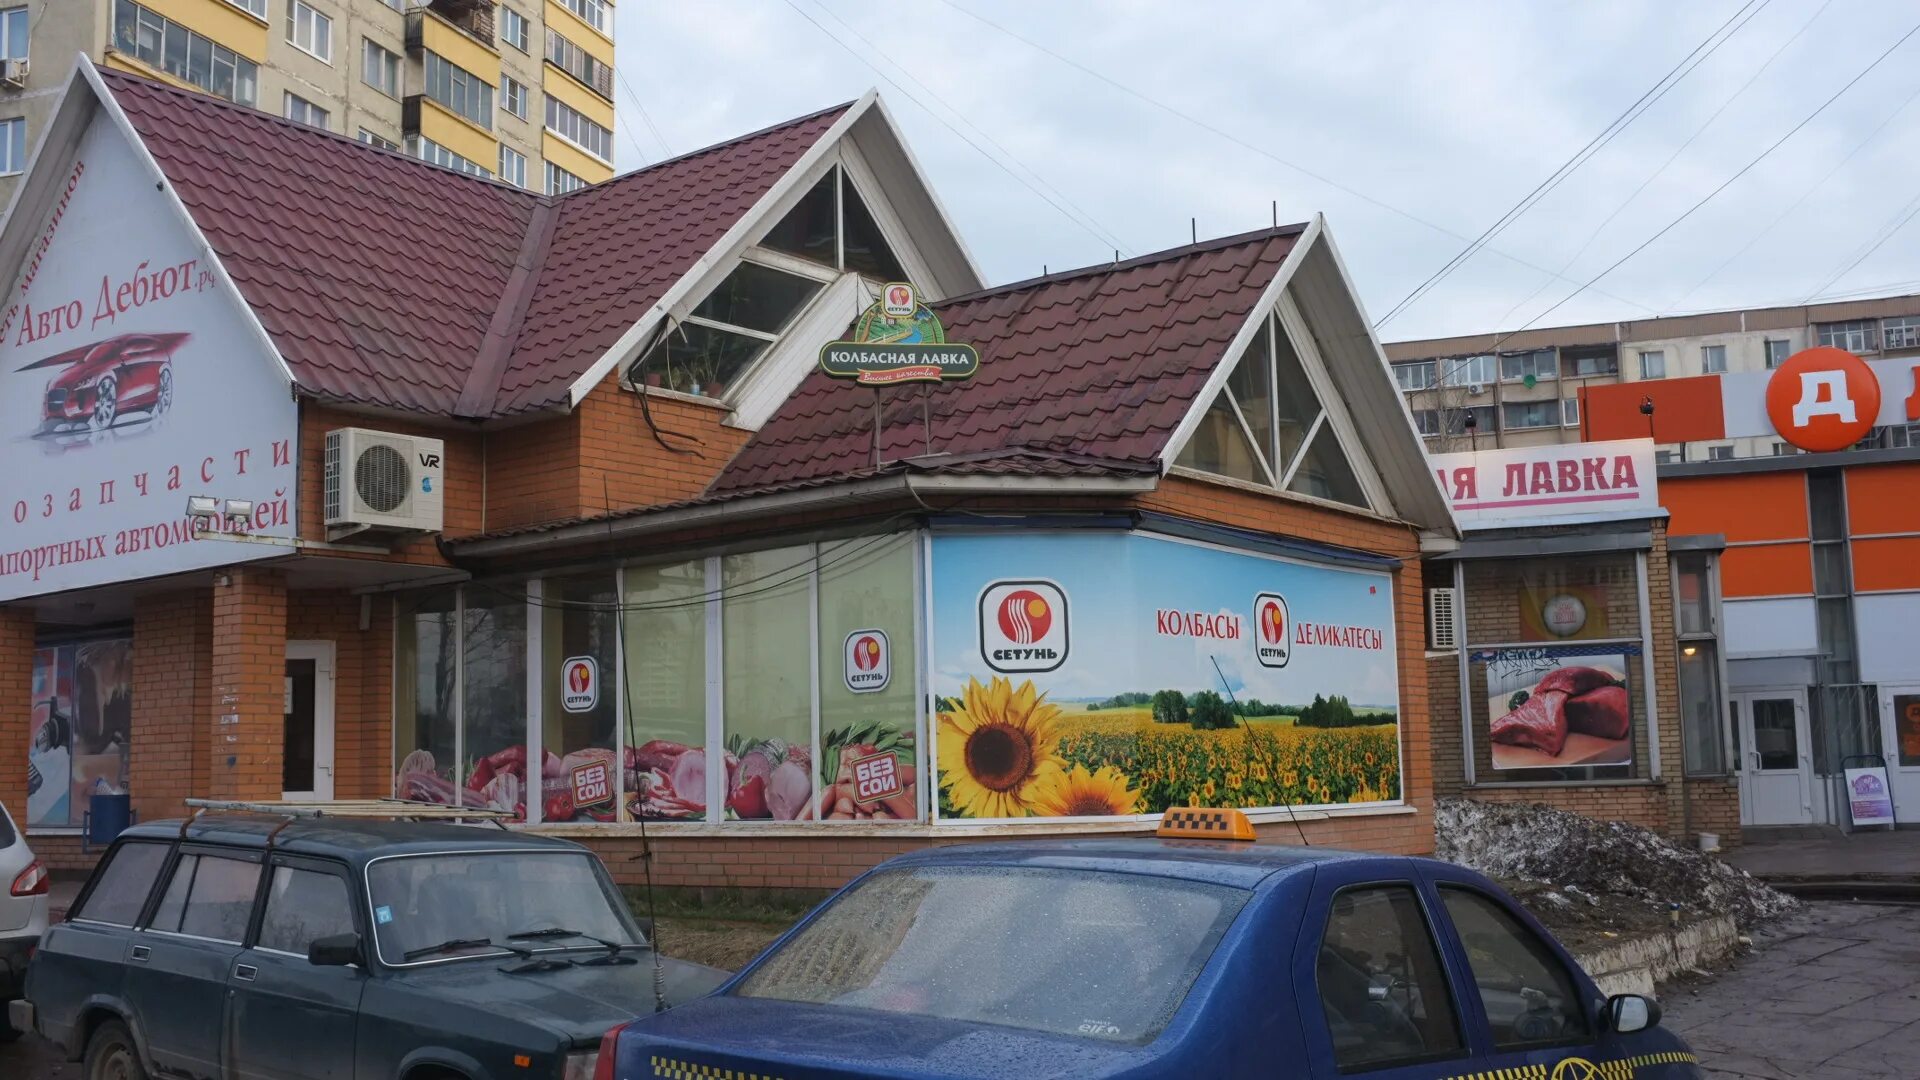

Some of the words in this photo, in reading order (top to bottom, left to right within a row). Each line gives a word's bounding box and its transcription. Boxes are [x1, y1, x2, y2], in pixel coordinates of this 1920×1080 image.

[20, 160, 85, 297] магазинов
[16, 300, 83, 347] Авто
[831, 352, 916, 364] КОЛБАСНАЯ
[921, 353, 969, 365] ЛАВКА
[1792, 369, 1858, 427] Д
[419, 453, 440, 468] VR
[1503, 455, 1639, 497] ЛАВКА
[115, 487, 289, 556] автомобей
[1157, 609, 1239, 639] КОЛБАСЫ
[1295, 623, 1382, 650] ДЕЛИКАТЕСЫ
[993, 648, 1058, 660] СЕТУНЬ
[1260, 648, 1286, 658] СЕТУНЬ
[852, 673, 883, 682] СЕТУНЬ
[575, 766, 605, 787] БЕЗ
[856, 757, 894, 782] БЕЗ
[577, 781, 606, 800] СОИ
[859, 774, 896, 797] СОИ
